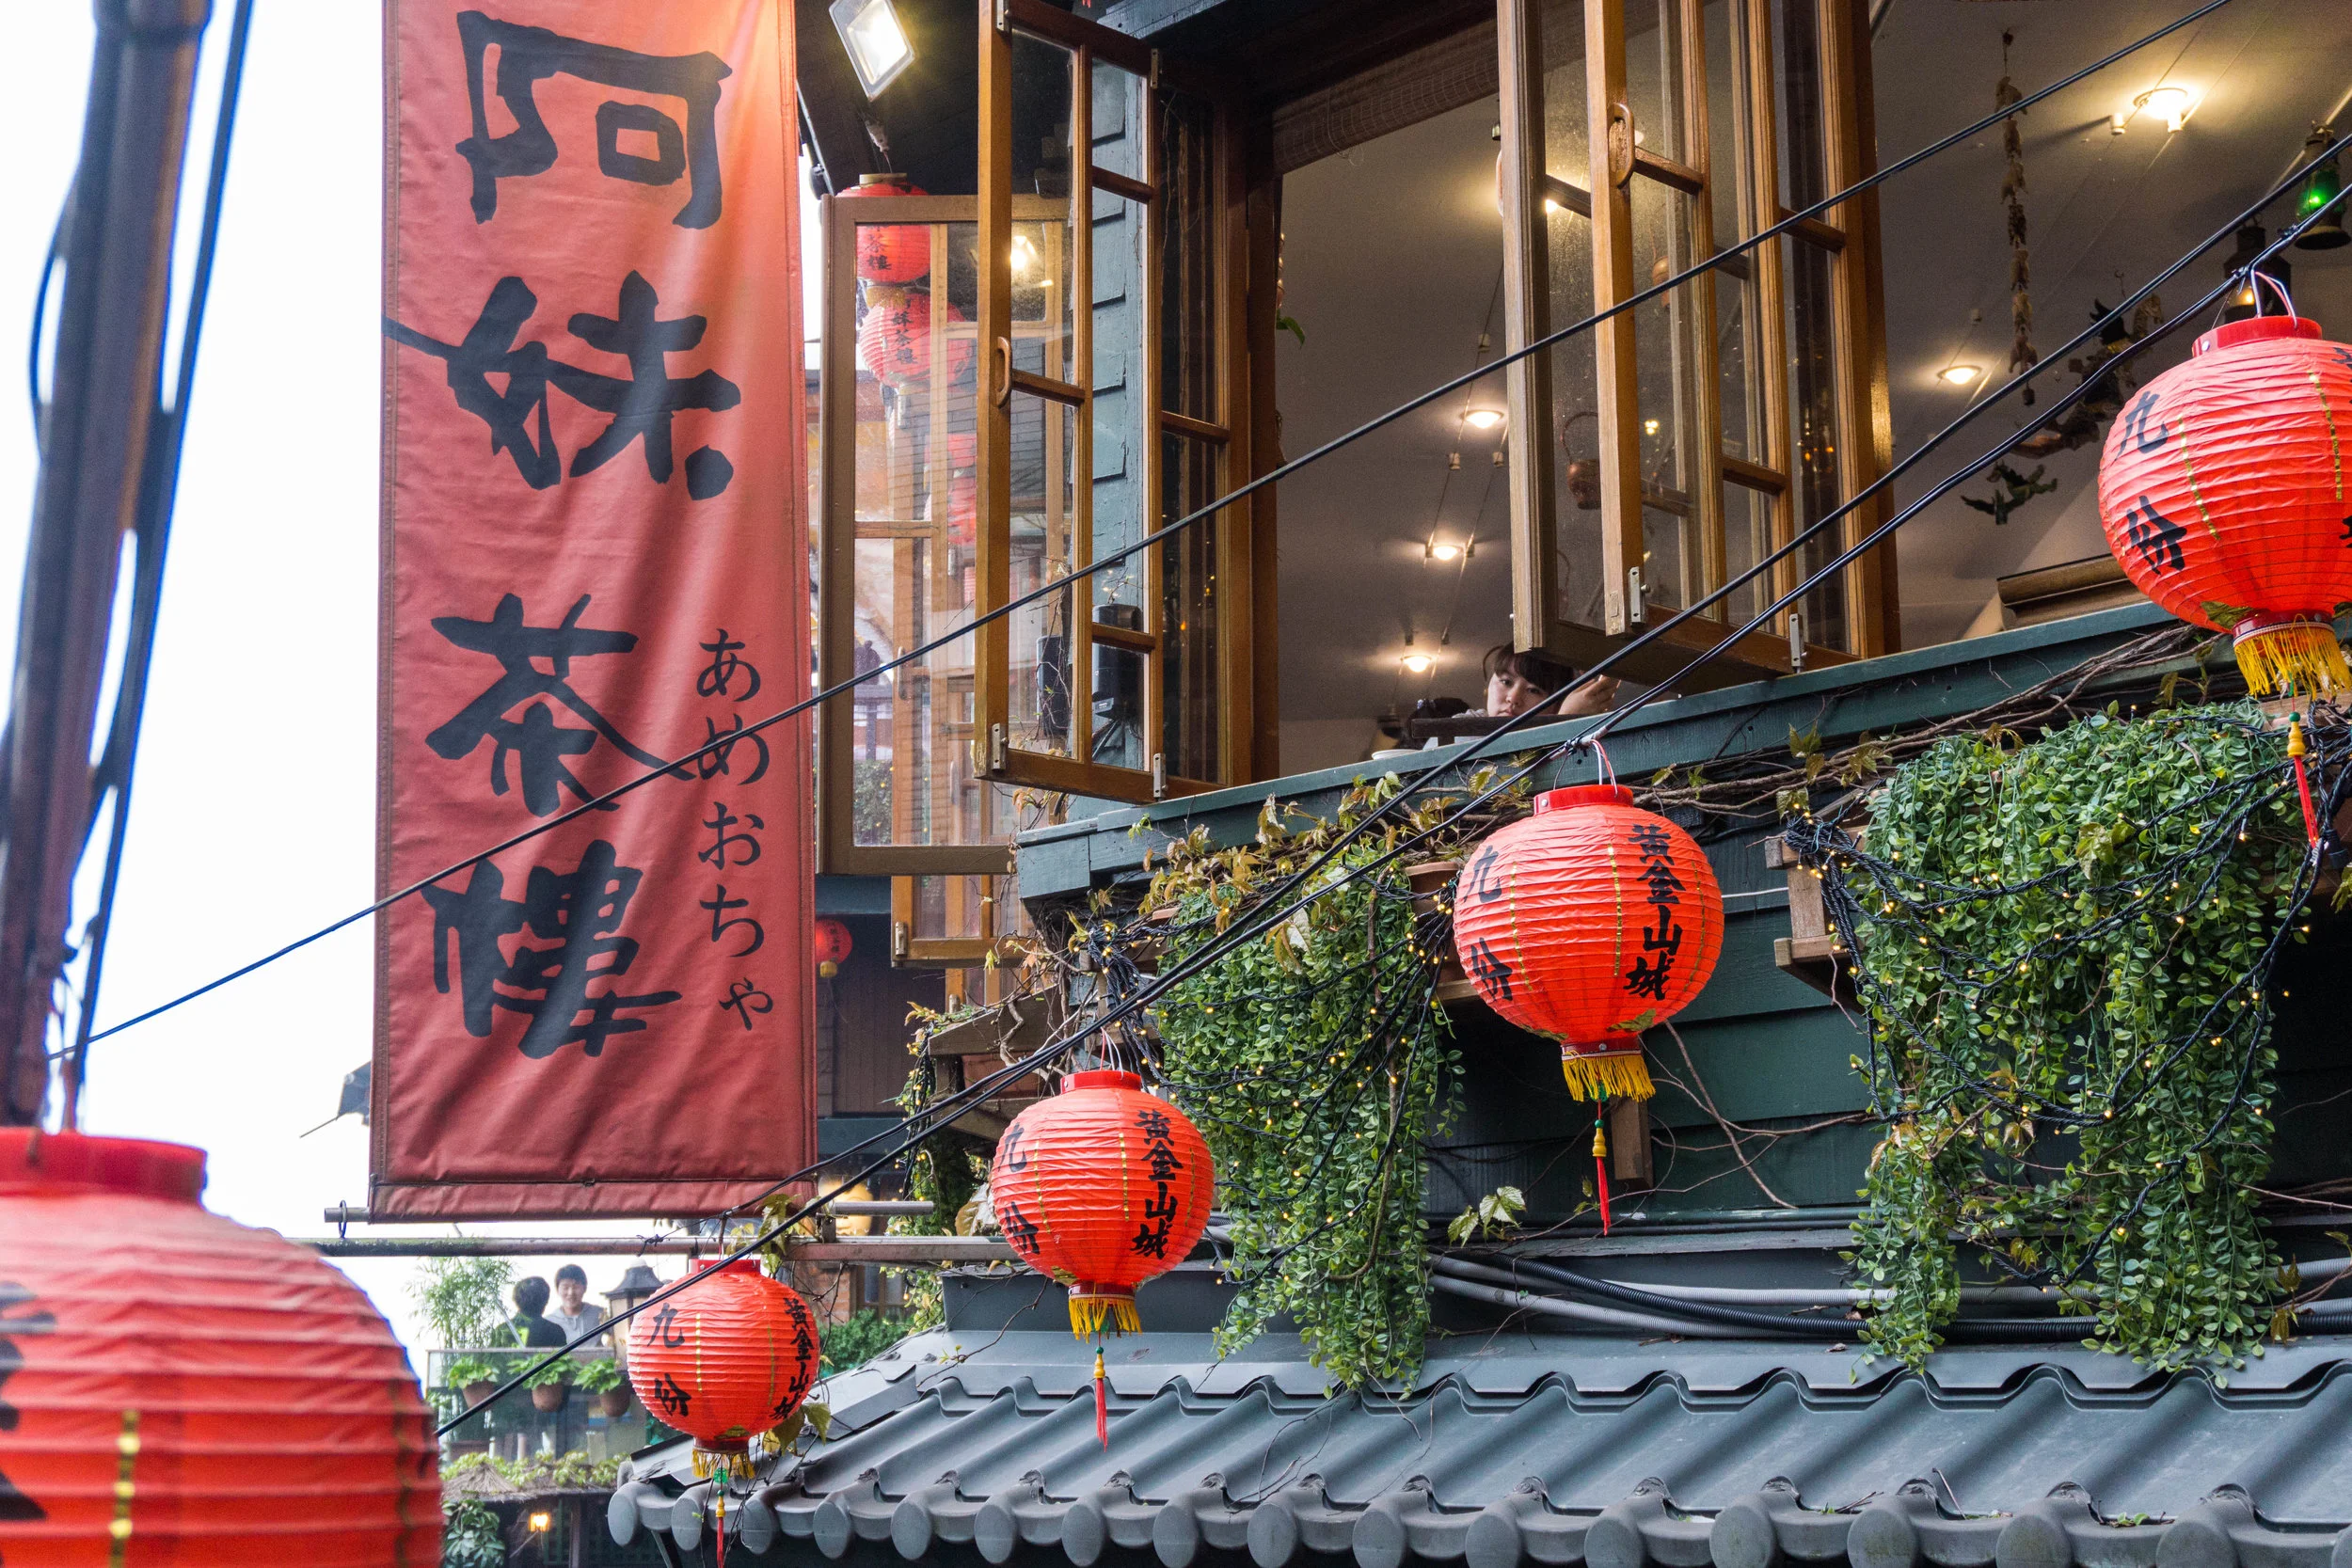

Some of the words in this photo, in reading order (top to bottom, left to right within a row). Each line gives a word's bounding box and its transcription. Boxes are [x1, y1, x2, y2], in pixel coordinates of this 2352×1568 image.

[381, 9, 741, 1059] 阿妹茶樓
[2115, 391, 2187, 575] 九份
[696, 628, 773, 1031] あめおちゃ
[1463, 845, 1513, 1001] 九份
[997, 1122, 1041, 1255] 九份
[646, 1302, 692, 1417] 九份
